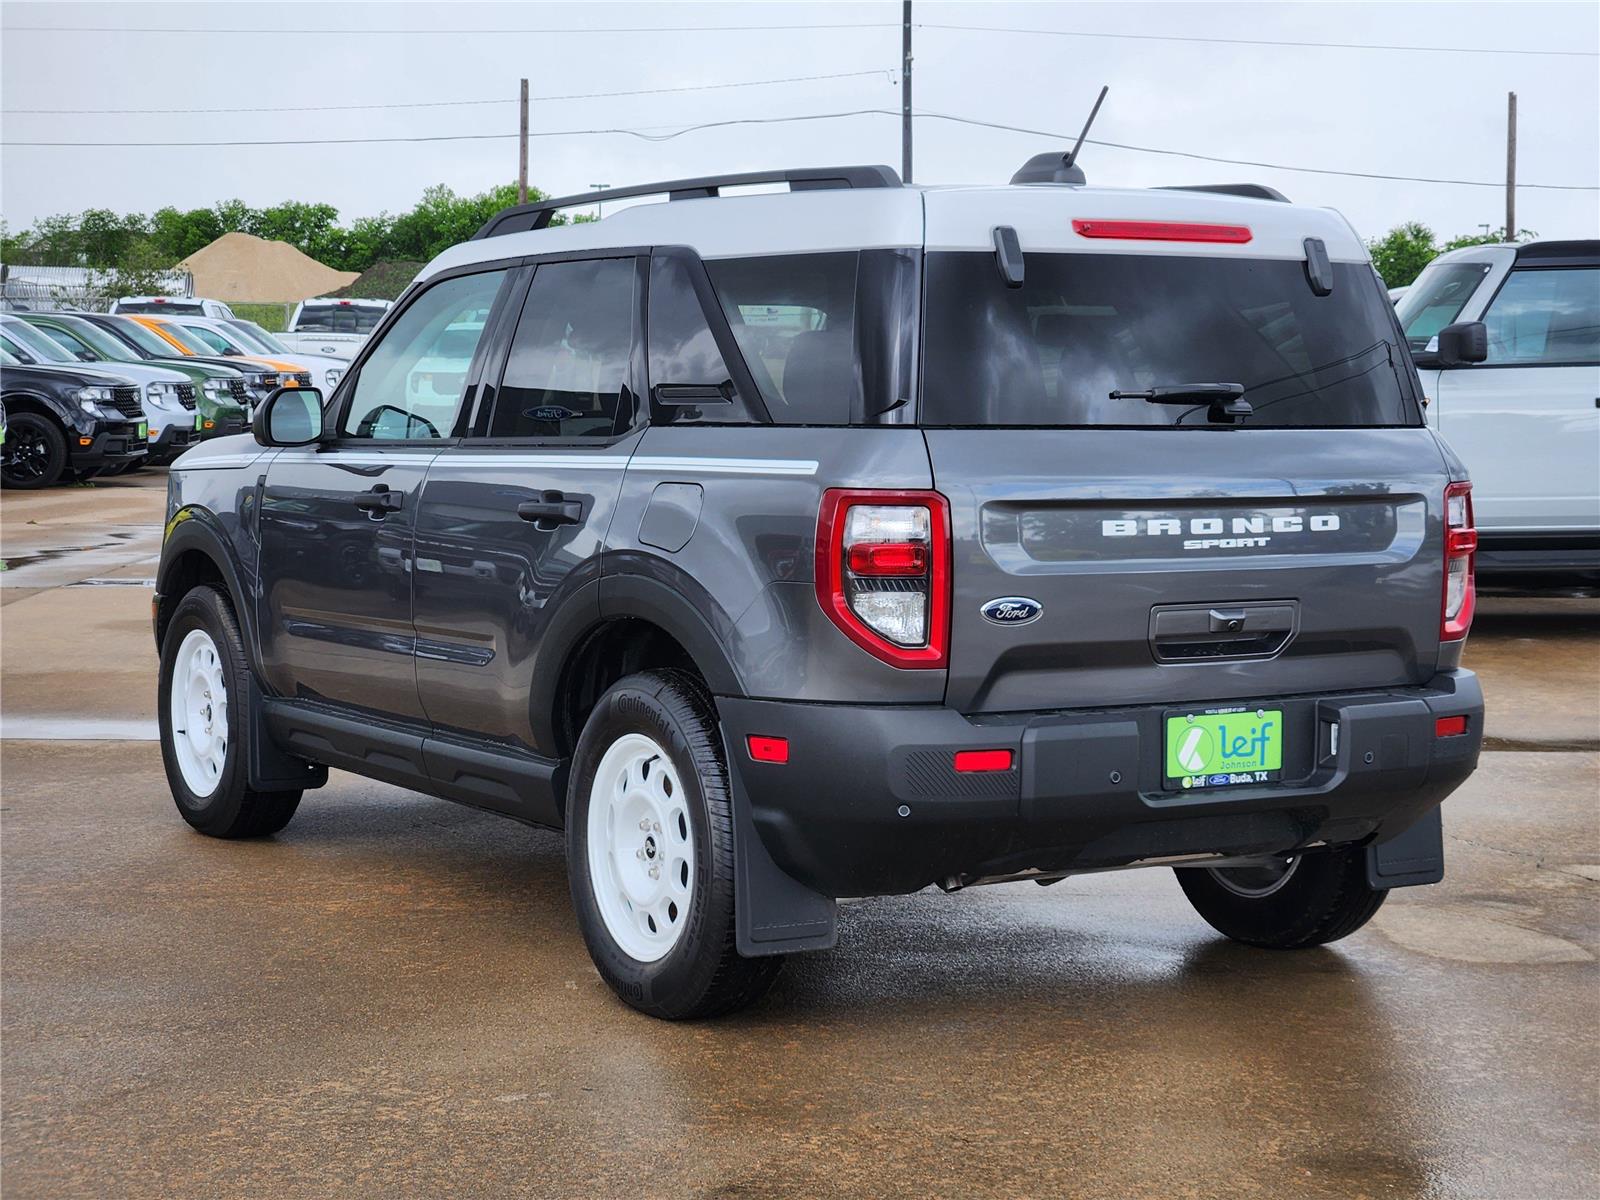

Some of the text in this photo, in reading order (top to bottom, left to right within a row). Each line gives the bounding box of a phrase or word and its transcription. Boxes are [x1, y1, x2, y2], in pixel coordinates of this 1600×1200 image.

[1102, 515, 1340, 537] BRONCO
[1183, 537, 1271, 550] SPORT
[996, 603, 1029, 618] Ford
[617, 693, 671, 737] Continental
[1218, 721, 1273, 766] leif
[1220, 760, 1257, 770] Johnson
[1229, 773, 1253, 784] Buda,
[1254, 771, 1268, 781] TX
